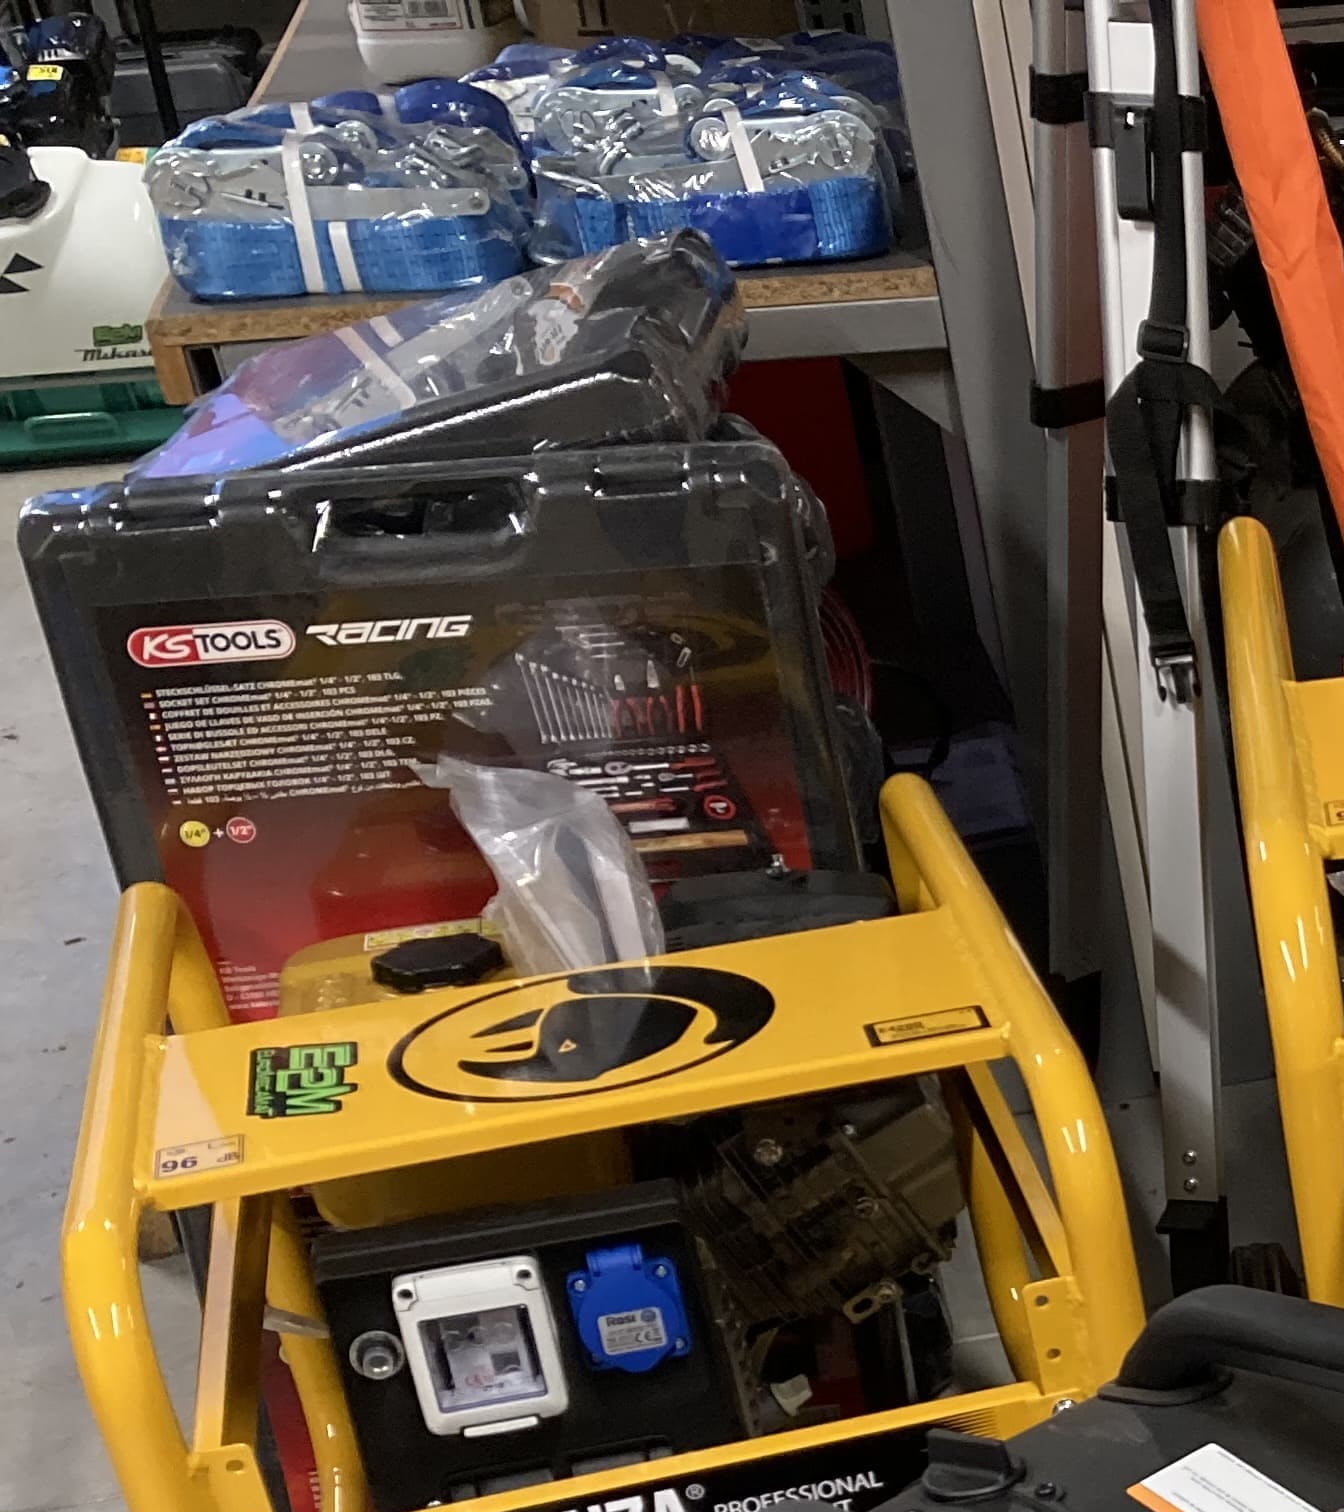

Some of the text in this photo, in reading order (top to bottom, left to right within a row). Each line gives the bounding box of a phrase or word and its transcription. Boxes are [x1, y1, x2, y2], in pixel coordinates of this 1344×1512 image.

[193, 628, 280, 654] TOOLS
[305, 615, 473, 646] RACING
[161, 1156, 197, 1173] 96
